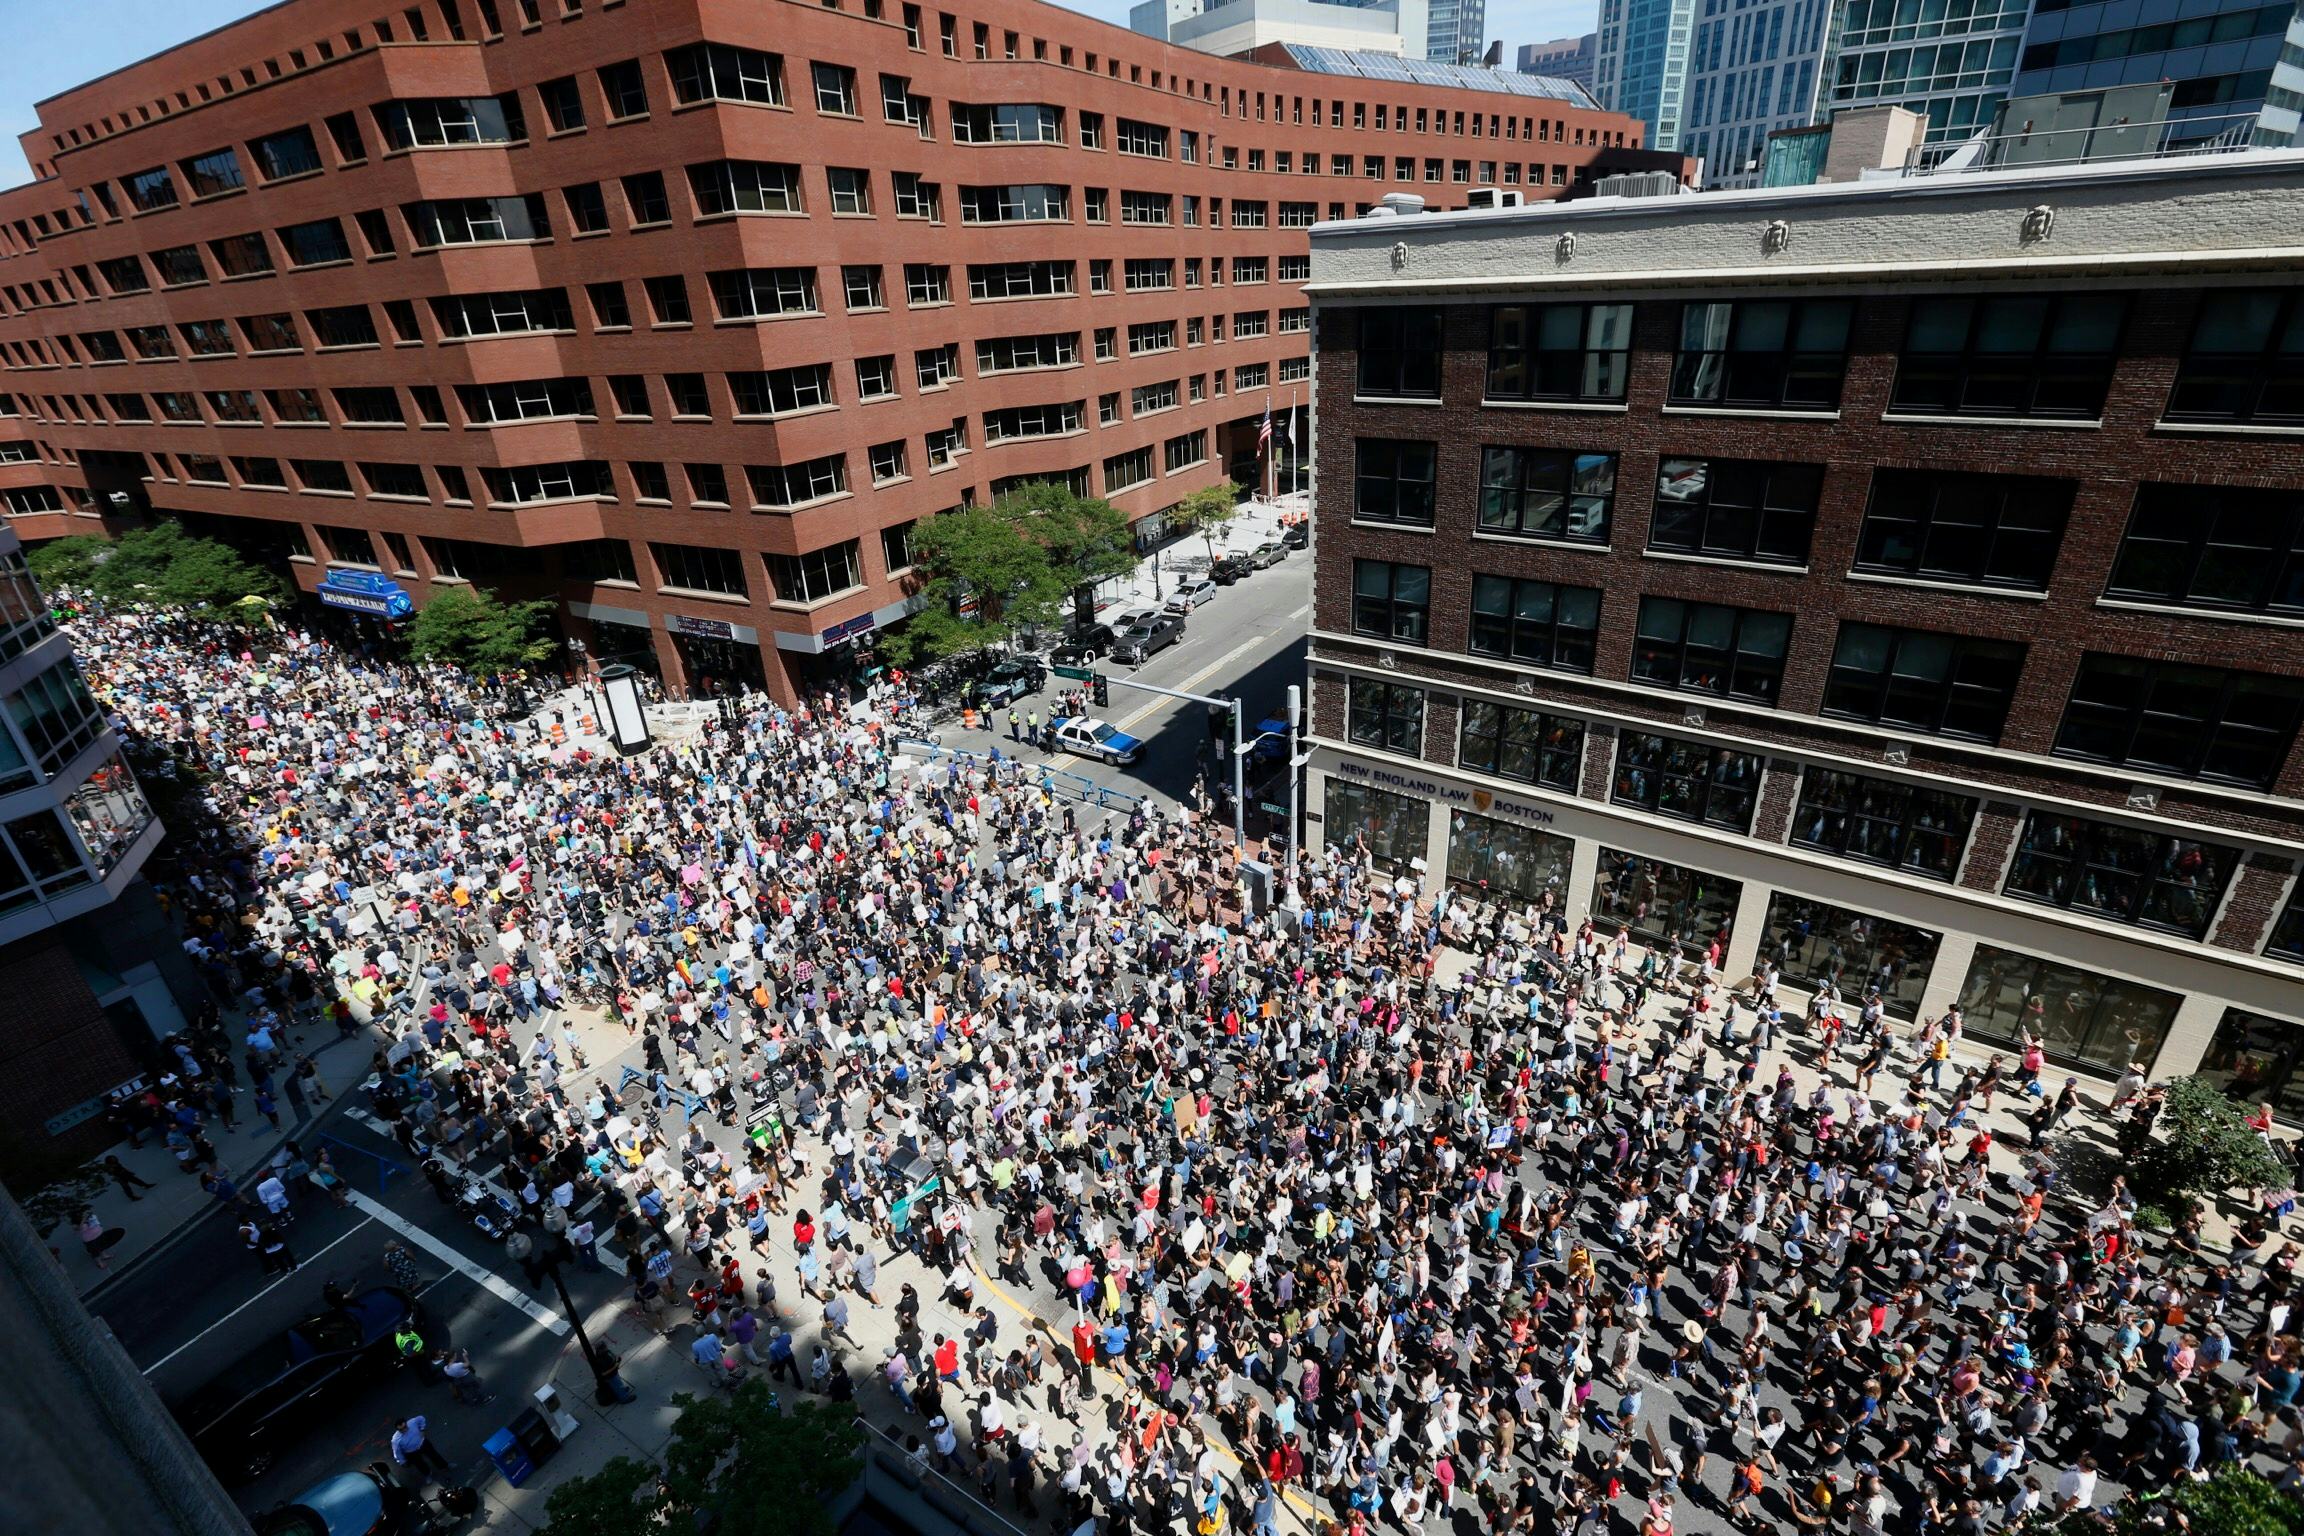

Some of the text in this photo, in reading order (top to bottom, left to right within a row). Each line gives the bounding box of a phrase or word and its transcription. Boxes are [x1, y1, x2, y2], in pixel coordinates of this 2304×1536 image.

[1340, 762, 1554, 824] NEW ENGLAND LAW BOSTON
